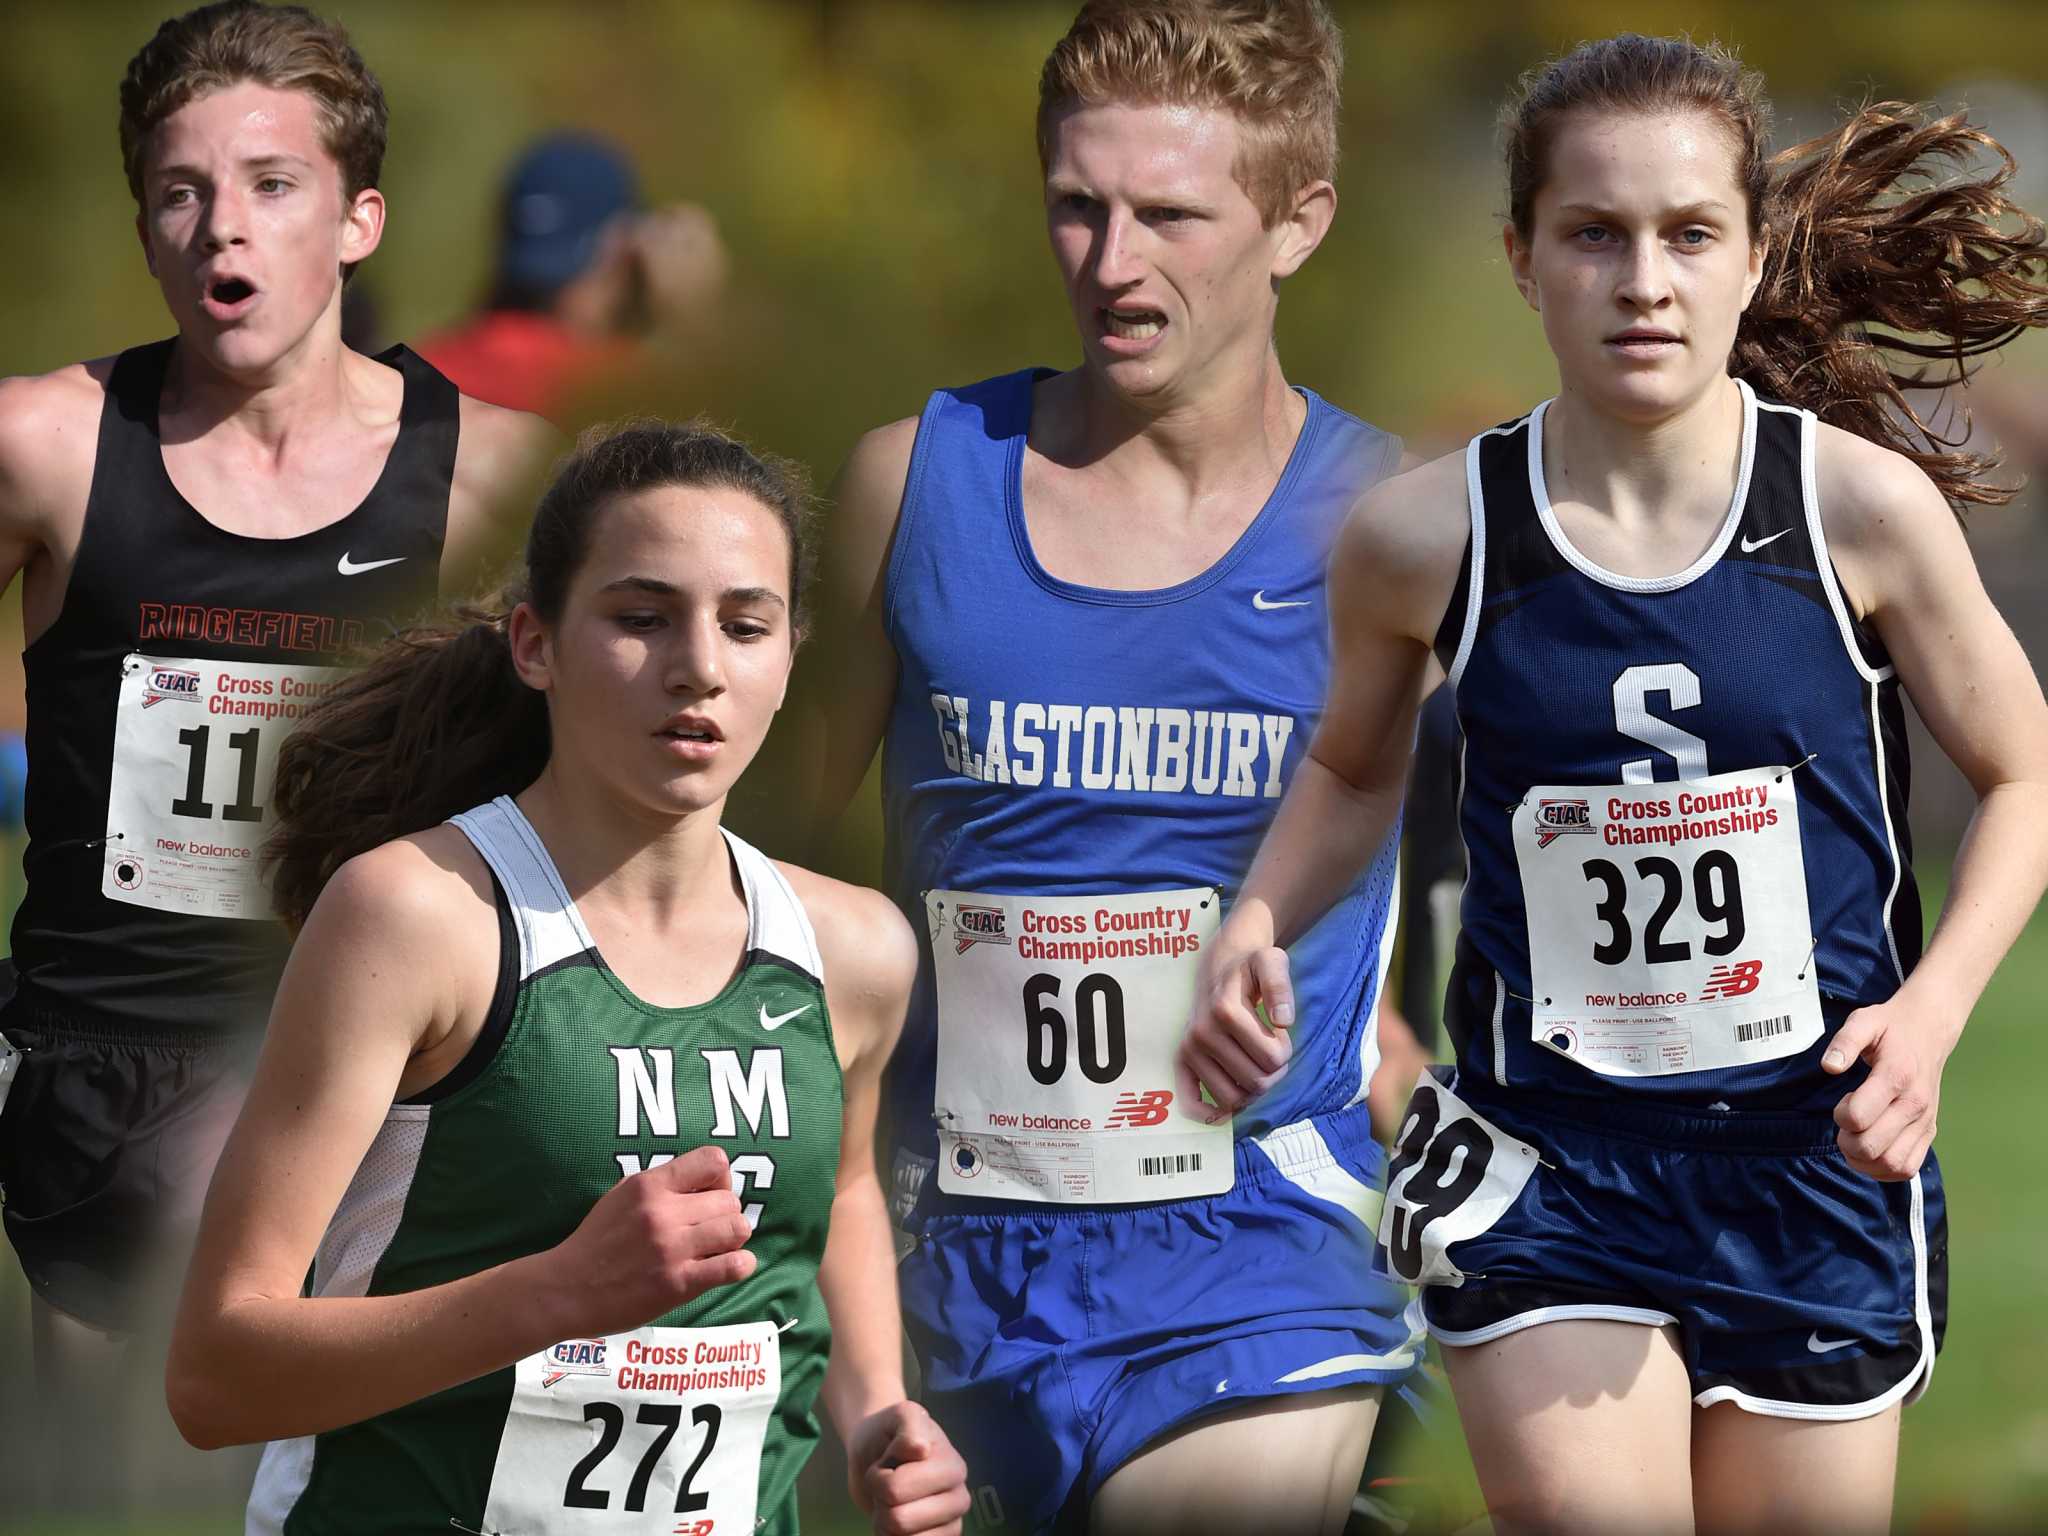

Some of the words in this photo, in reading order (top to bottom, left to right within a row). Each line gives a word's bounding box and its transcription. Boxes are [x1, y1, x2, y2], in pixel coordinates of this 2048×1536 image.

[140, 603, 364, 653] RIDGEFIELD
[154, 672, 201, 693] CIAC
[217, 673, 274, 695] Cross
[1613, 662, 1710, 784] S
[931, 693, 1294, 799] GLASTONBURY
[172, 725, 264, 822] 11
[1544, 805, 1590, 825] CIAC
[1607, 796, 1671, 820] Cross
[1678, 785, 1769, 816] Country
[1603, 805, 1779, 847] Championships
[157, 838, 186, 852] new
[189, 841, 252, 858] balance
[961, 910, 1006, 934] CIAC
[1022, 908, 1087, 934] Cross
[1094, 905, 1192, 932] Country
[1581, 849, 1746, 965] 329
[1018, 932, 1200, 965] Championships
[1585, 992, 1616, 1007] new
[1619, 989, 1688, 1007] balance
[1022, 972, 1128, 1086] 60
[988, 1111, 1019, 1127] new
[1022, 1112, 1092, 1131] balance
[553, 1343, 607, 1364] CIAC
[626, 1339, 688, 1365] Cross
[694, 1338, 762, 1364] Country
[617, 1364, 766, 1396] Championships
[562, 1401, 722, 1513] 272
